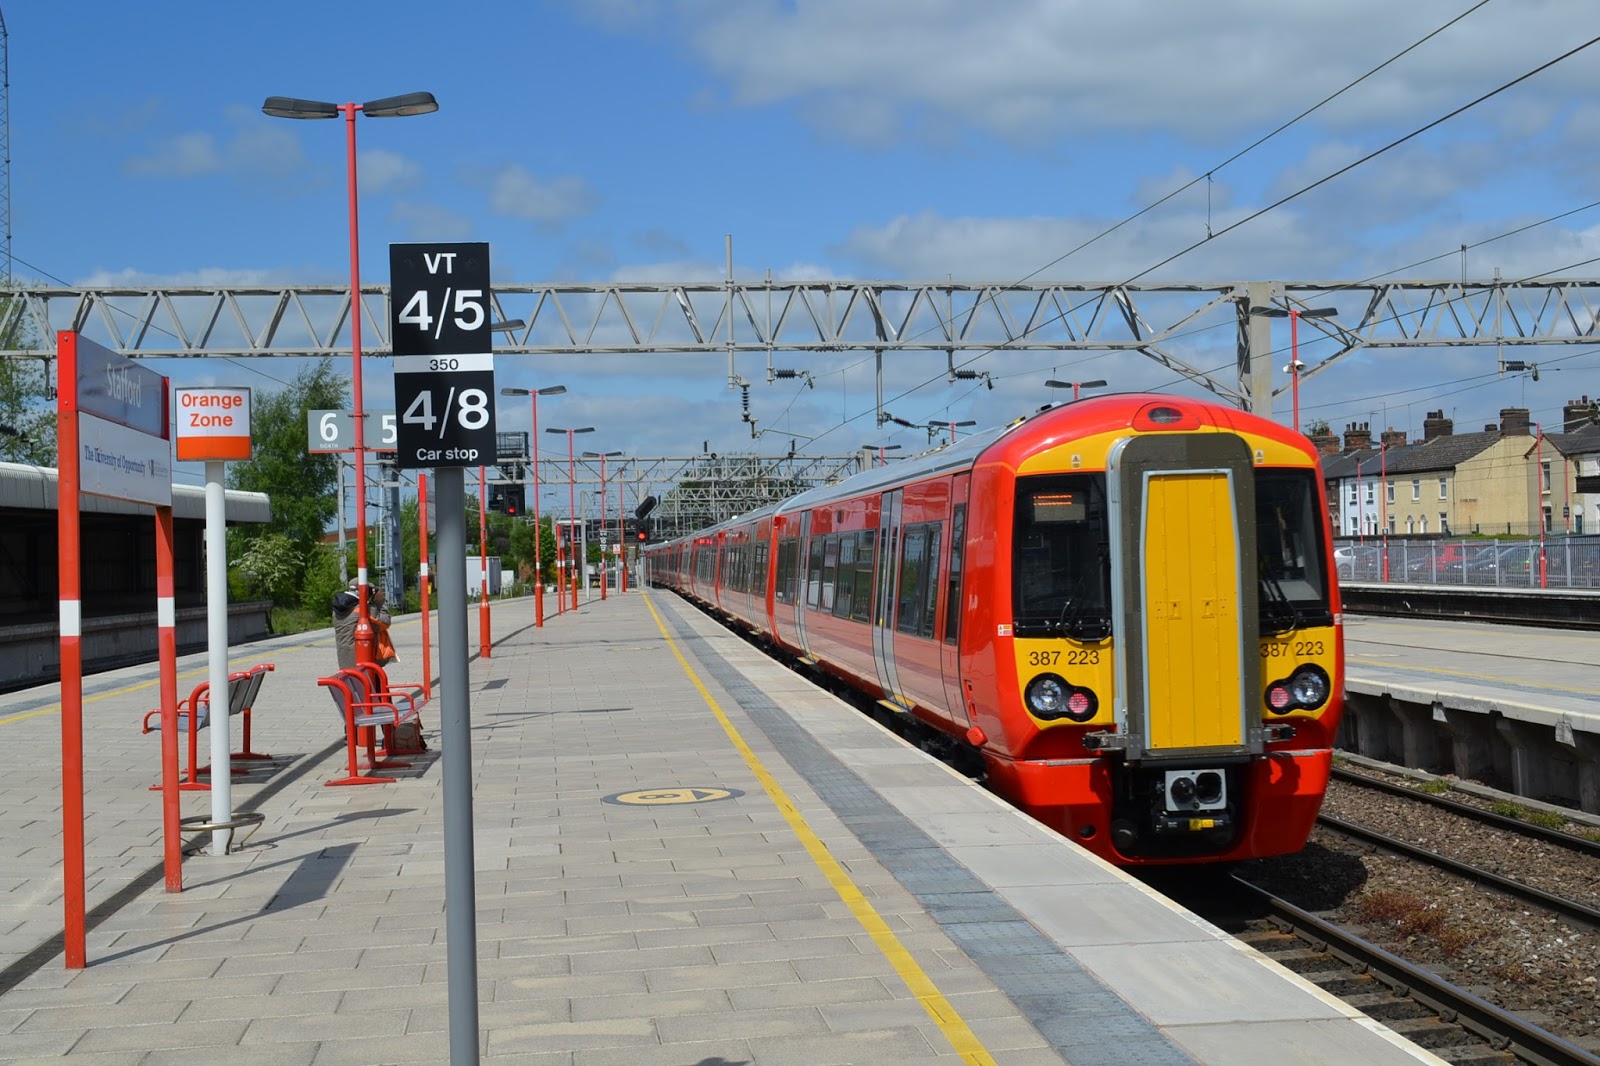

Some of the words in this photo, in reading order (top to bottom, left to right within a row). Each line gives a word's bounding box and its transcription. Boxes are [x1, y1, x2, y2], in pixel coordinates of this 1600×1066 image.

[423, 253, 457, 274] VT
[398, 287, 485, 340] 4/5
[429, 359, 459, 371] 350
[106, 363, 141, 408] Stafford
[181, 393, 243, 410] Orange
[190, 413, 233, 427] Zone
[402, 386, 490, 440] 4/8
[320, 412, 339, 442] 6
[382, 414, 398, 444] 5
[84, 445, 94, 461] The
[94, 447, 117, 470] University
[117, 454, 122, 468] of
[122, 455, 145, 477] Opportunity
[416, 448, 442, 461] Car
[445, 447, 479, 461] stop
[1029, 651, 1061, 666] 387
[1067, 650, 1100, 665] 223
[1260, 642, 1289, 657] 387
[1295, 641, 1325, 656] 223
